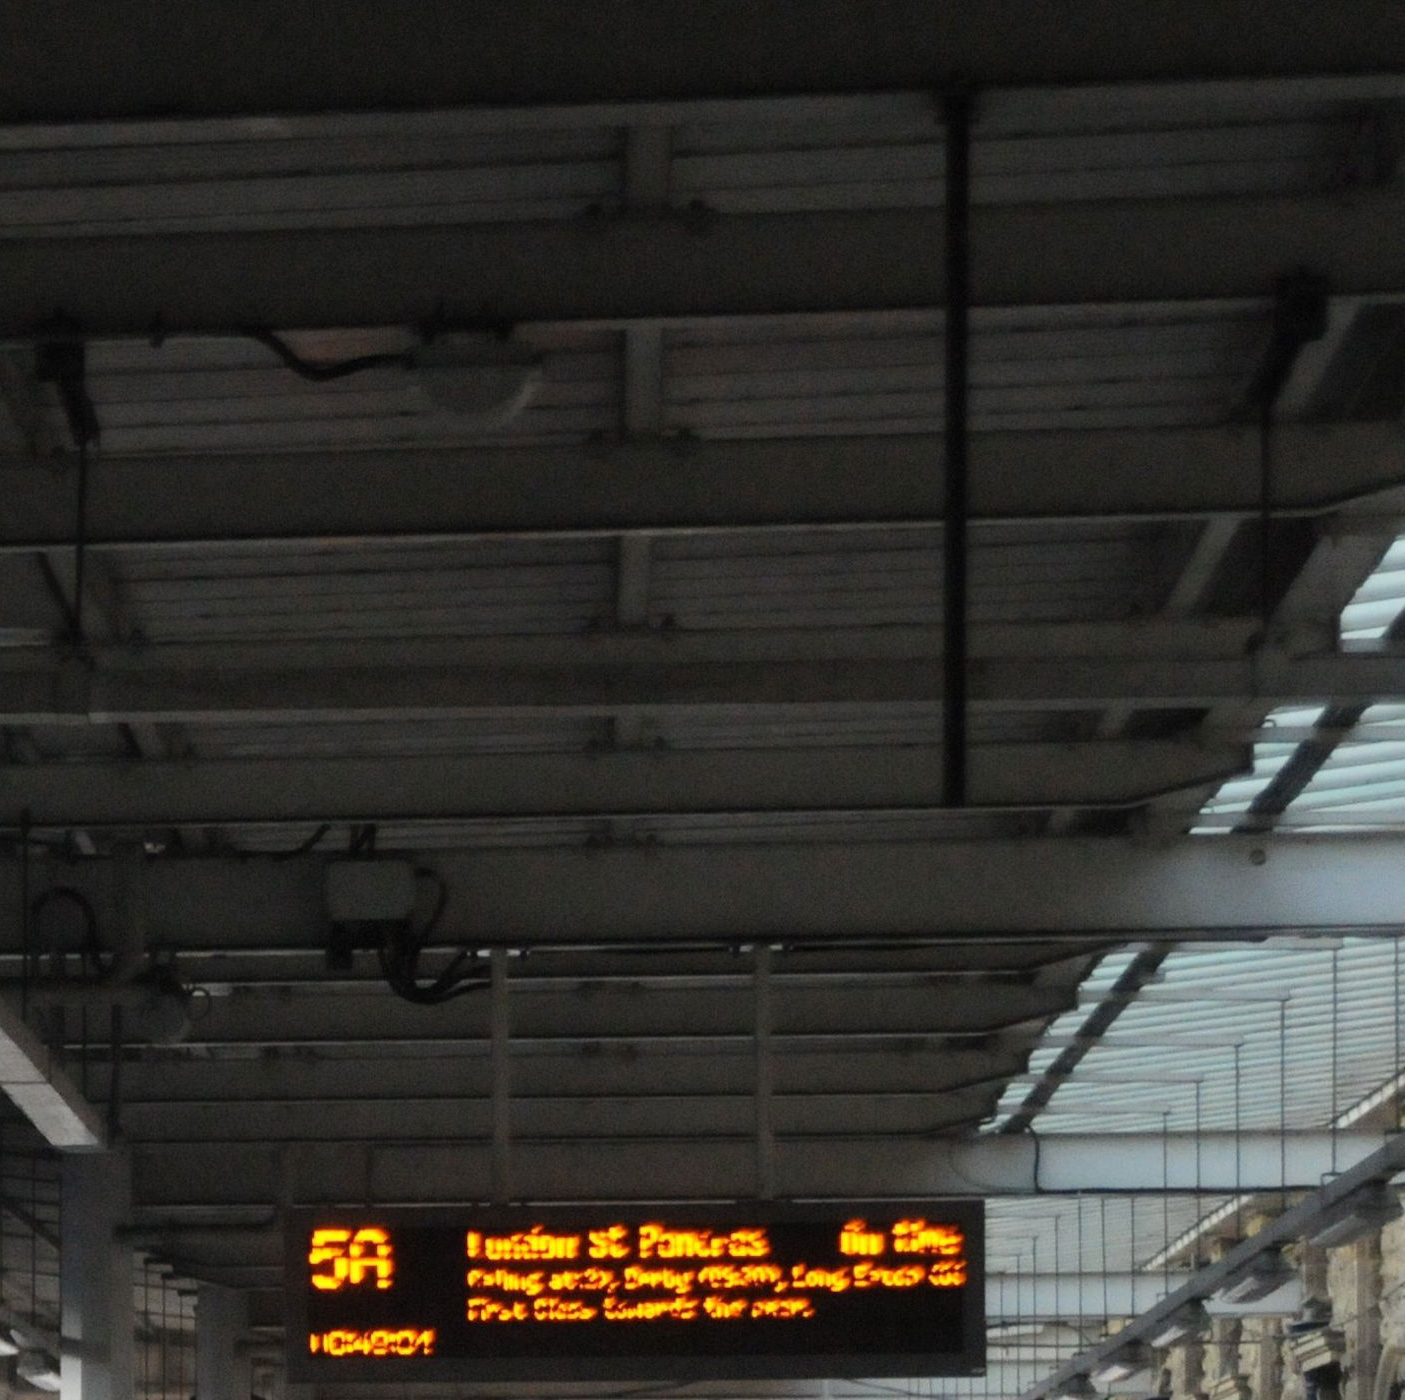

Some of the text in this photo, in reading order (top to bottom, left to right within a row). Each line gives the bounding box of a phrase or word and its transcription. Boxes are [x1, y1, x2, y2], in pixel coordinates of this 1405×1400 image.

[308, 1227, 394, 1290] 5A
[466, 1223, 771, 1260] London St Pancras
